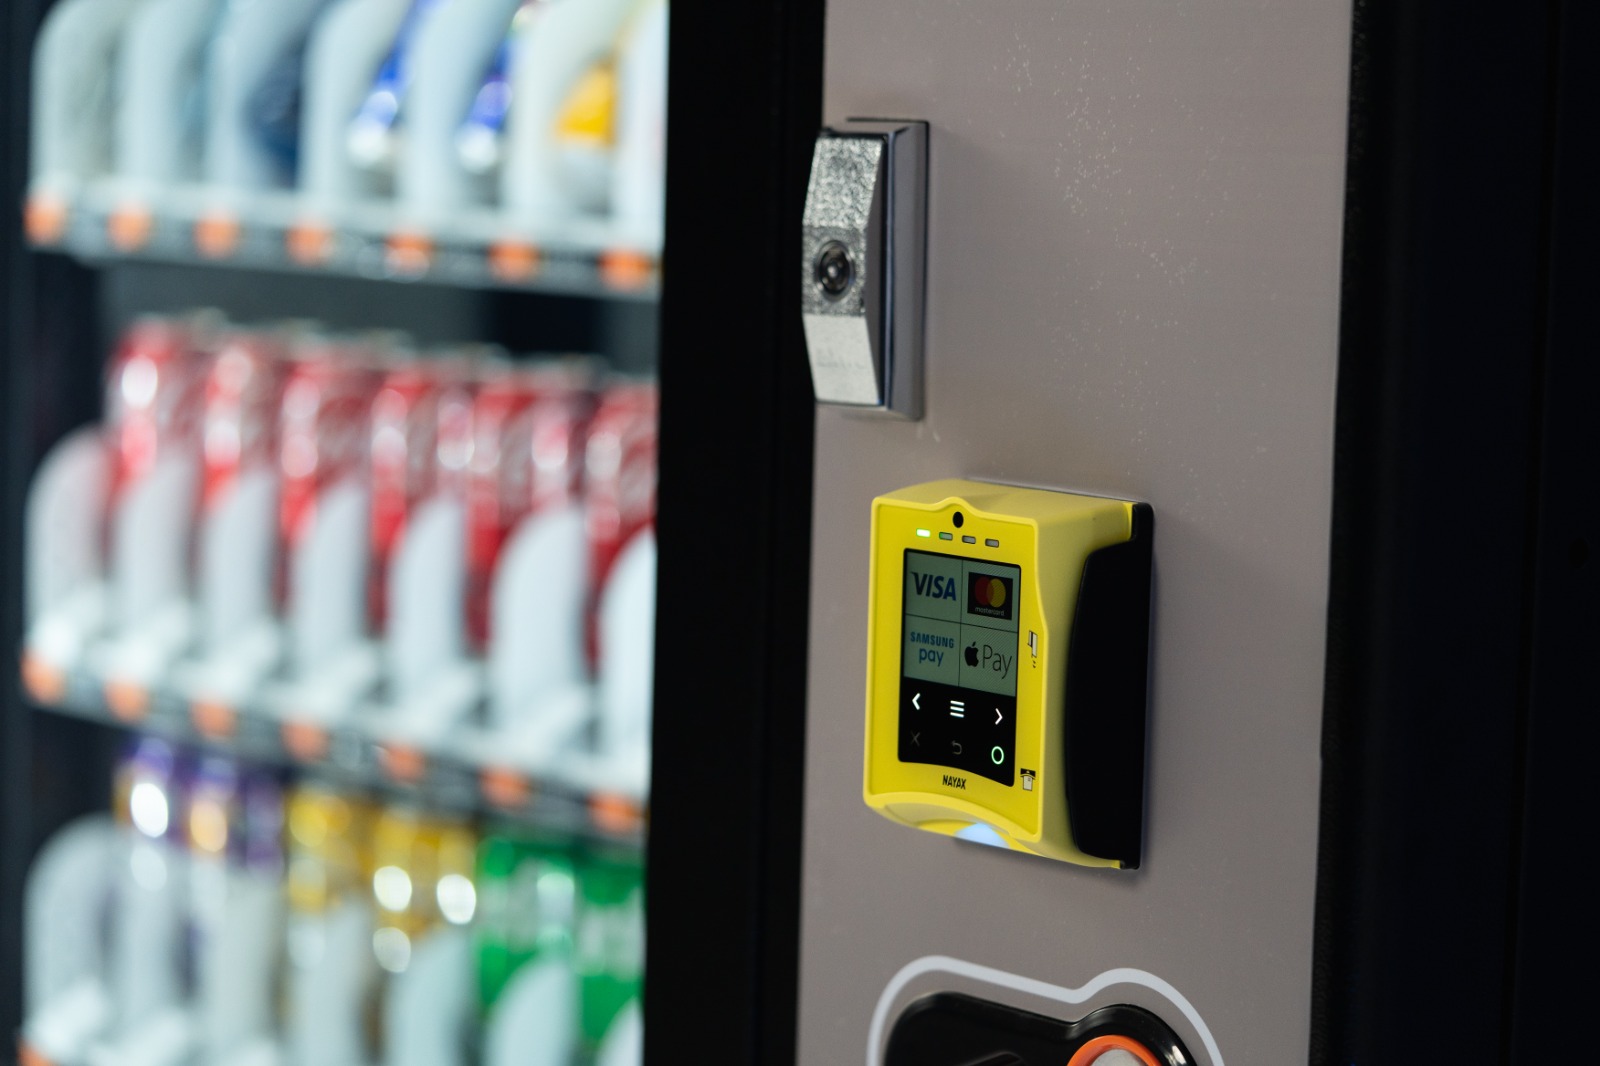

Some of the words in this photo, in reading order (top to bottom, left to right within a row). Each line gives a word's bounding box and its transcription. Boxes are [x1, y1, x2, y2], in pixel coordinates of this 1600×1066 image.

[910, 571, 957, 601] VISA
[974, 605, 1005, 617] mastercard
[910, 631, 955, 649] SAMSUNG
[918, 647, 944, 667] pay
[982, 644, 1012, 680] Pay
[942, 774, 967, 790] NAYAX
